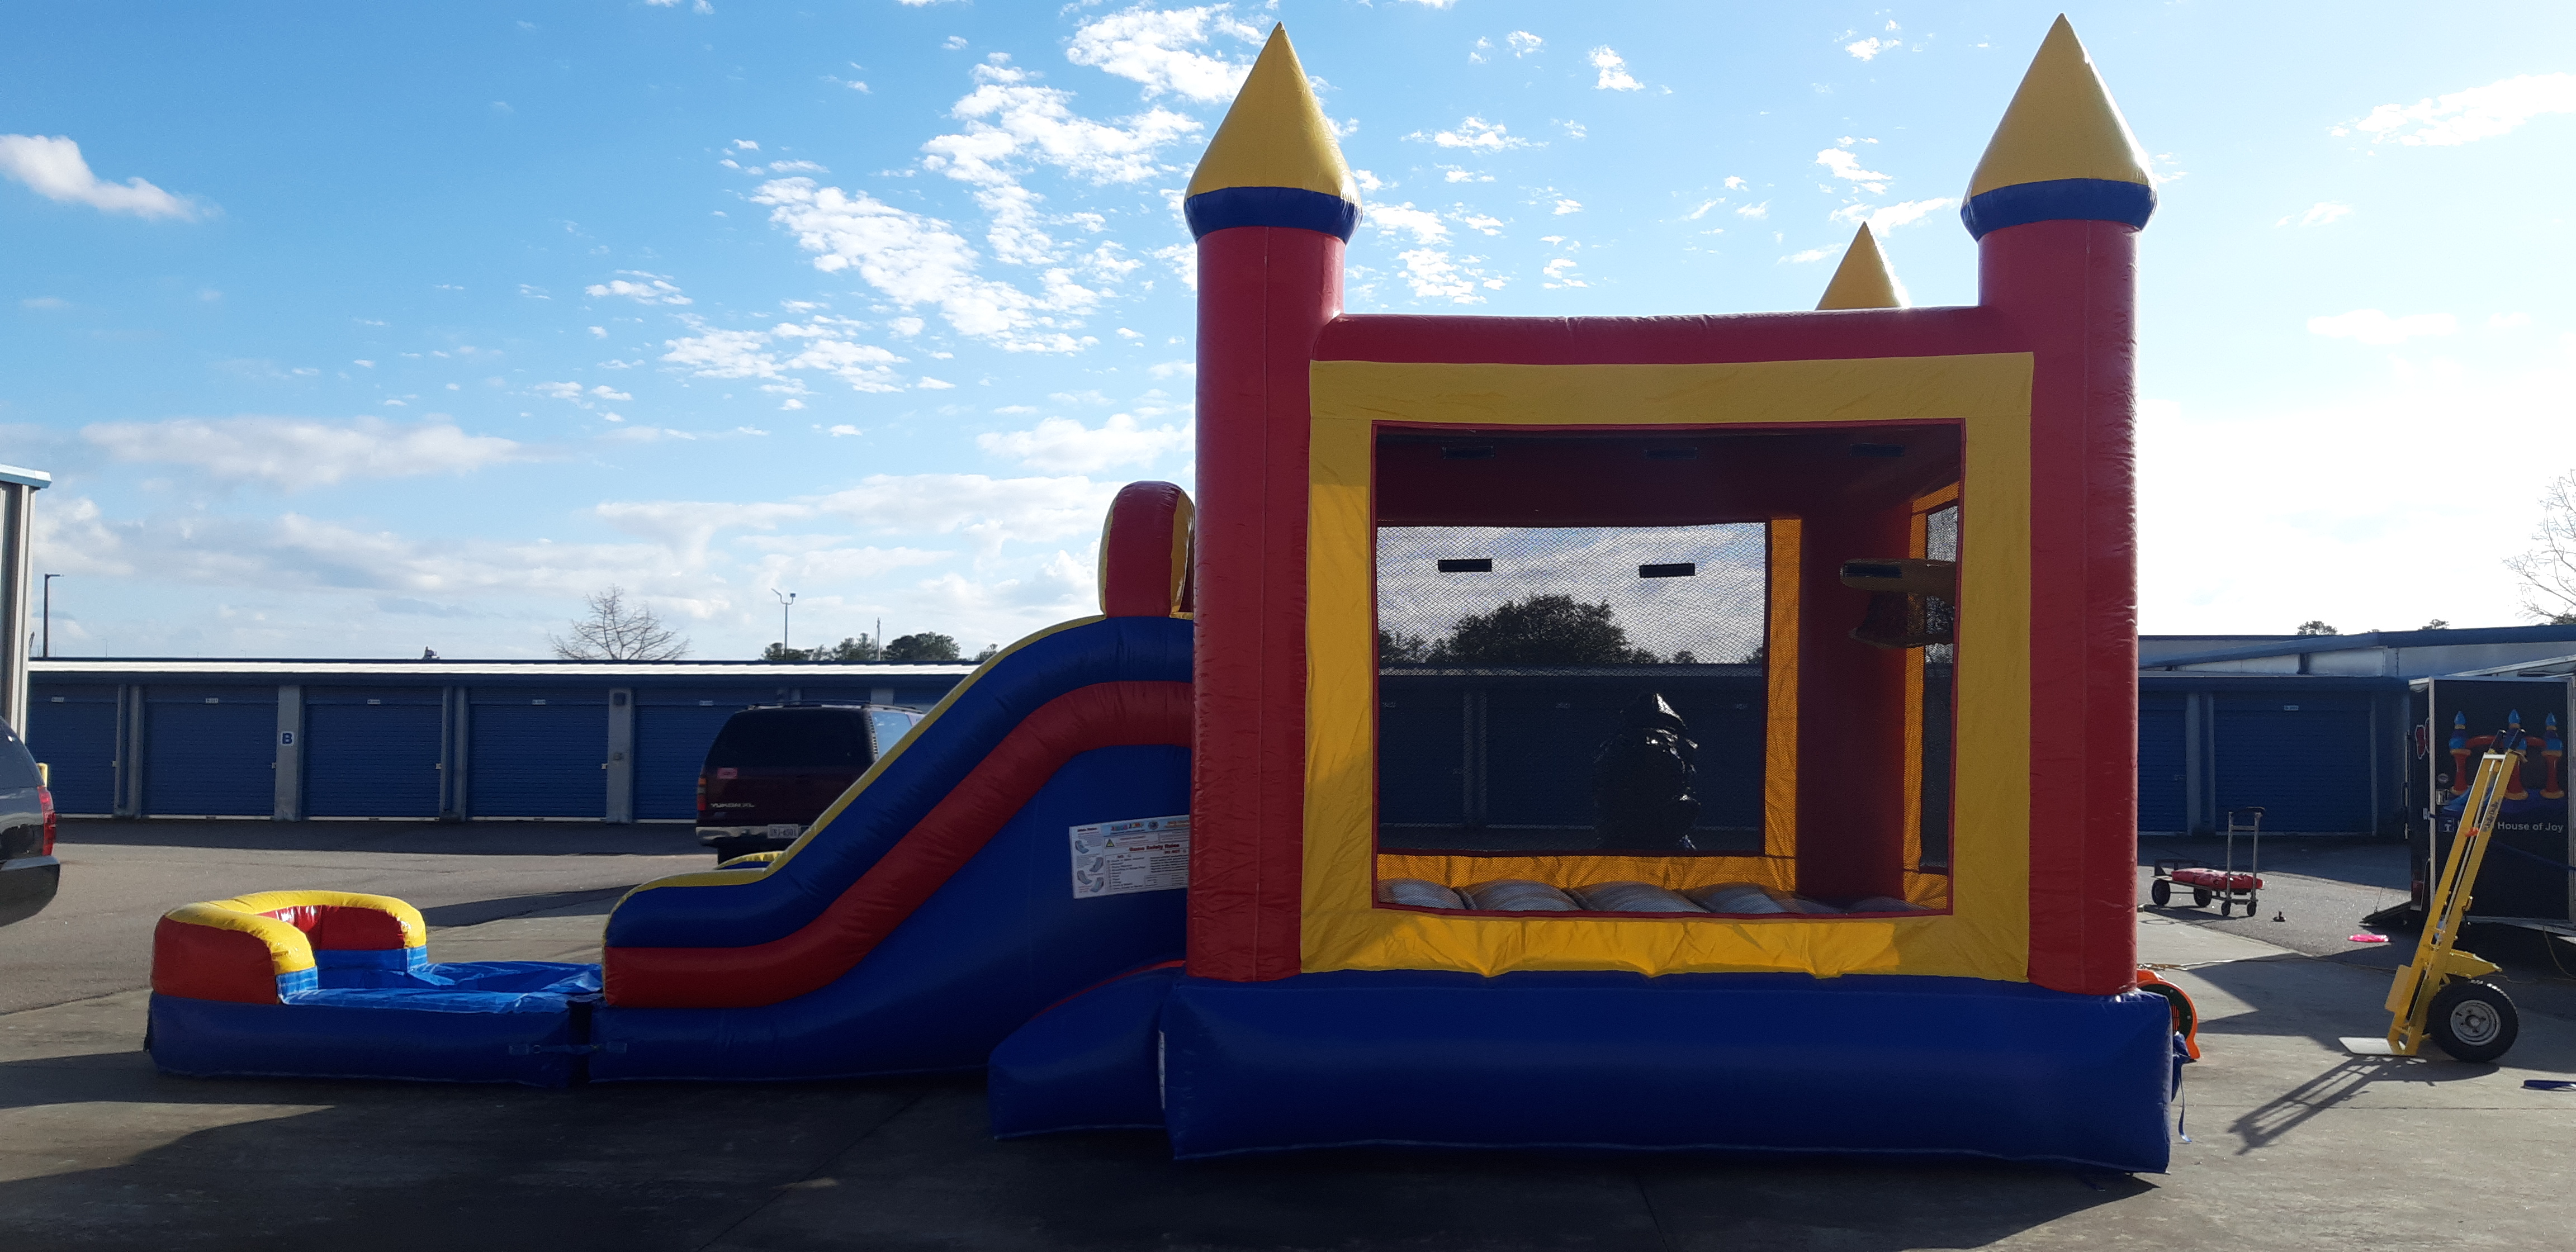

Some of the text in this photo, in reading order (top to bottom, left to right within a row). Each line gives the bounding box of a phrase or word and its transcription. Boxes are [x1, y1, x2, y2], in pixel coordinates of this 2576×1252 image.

[282, 733, 292, 744] B
[2497, 821, 2530, 831] House
[2532, 822, 2544, 831] of
[2545, 822, 2564, 833] Joy
